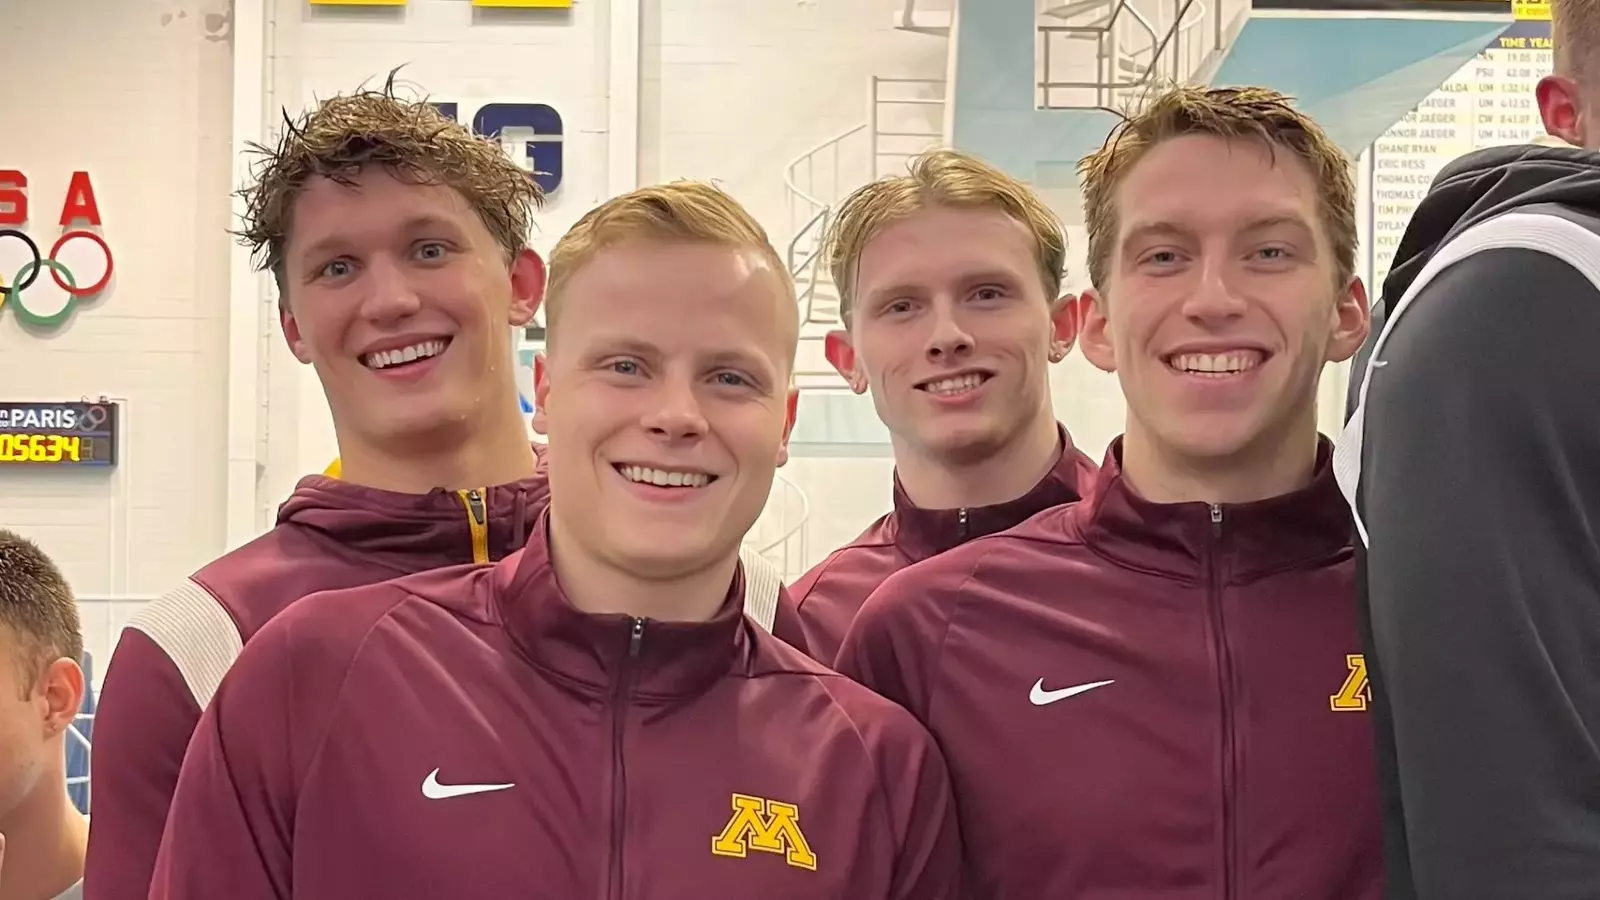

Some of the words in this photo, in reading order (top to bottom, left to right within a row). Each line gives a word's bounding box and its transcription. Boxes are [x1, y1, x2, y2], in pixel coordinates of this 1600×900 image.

[1500, 38, 1525, 48] TIME
[1530, 38, 1553, 48] YEA
[1476, 68, 1494, 78] PSU
[1479, 84, 1494, 93] UM
[1479, 99, 1494, 108] UM
[1419, 114, 1456, 123] JAEGER
[1419, 129, 1456, 138] JAEGER
[1479, 129, 1493, 138] UM
[1378, 144, 1408, 153] SHANE
[1411, 144, 1437, 153] RYAN
[1378, 159, 1399, 169] ERIC
[1401, 159, 1426, 169] RESS
[1377, 174, 1416, 184] THOMAS
[1377, 189, 1416, 199] THOMAS
[1377, 205, 1393, 214] TIM
[10, 408, 76, 429] PARIS
[712, 793, 817, 871] M
